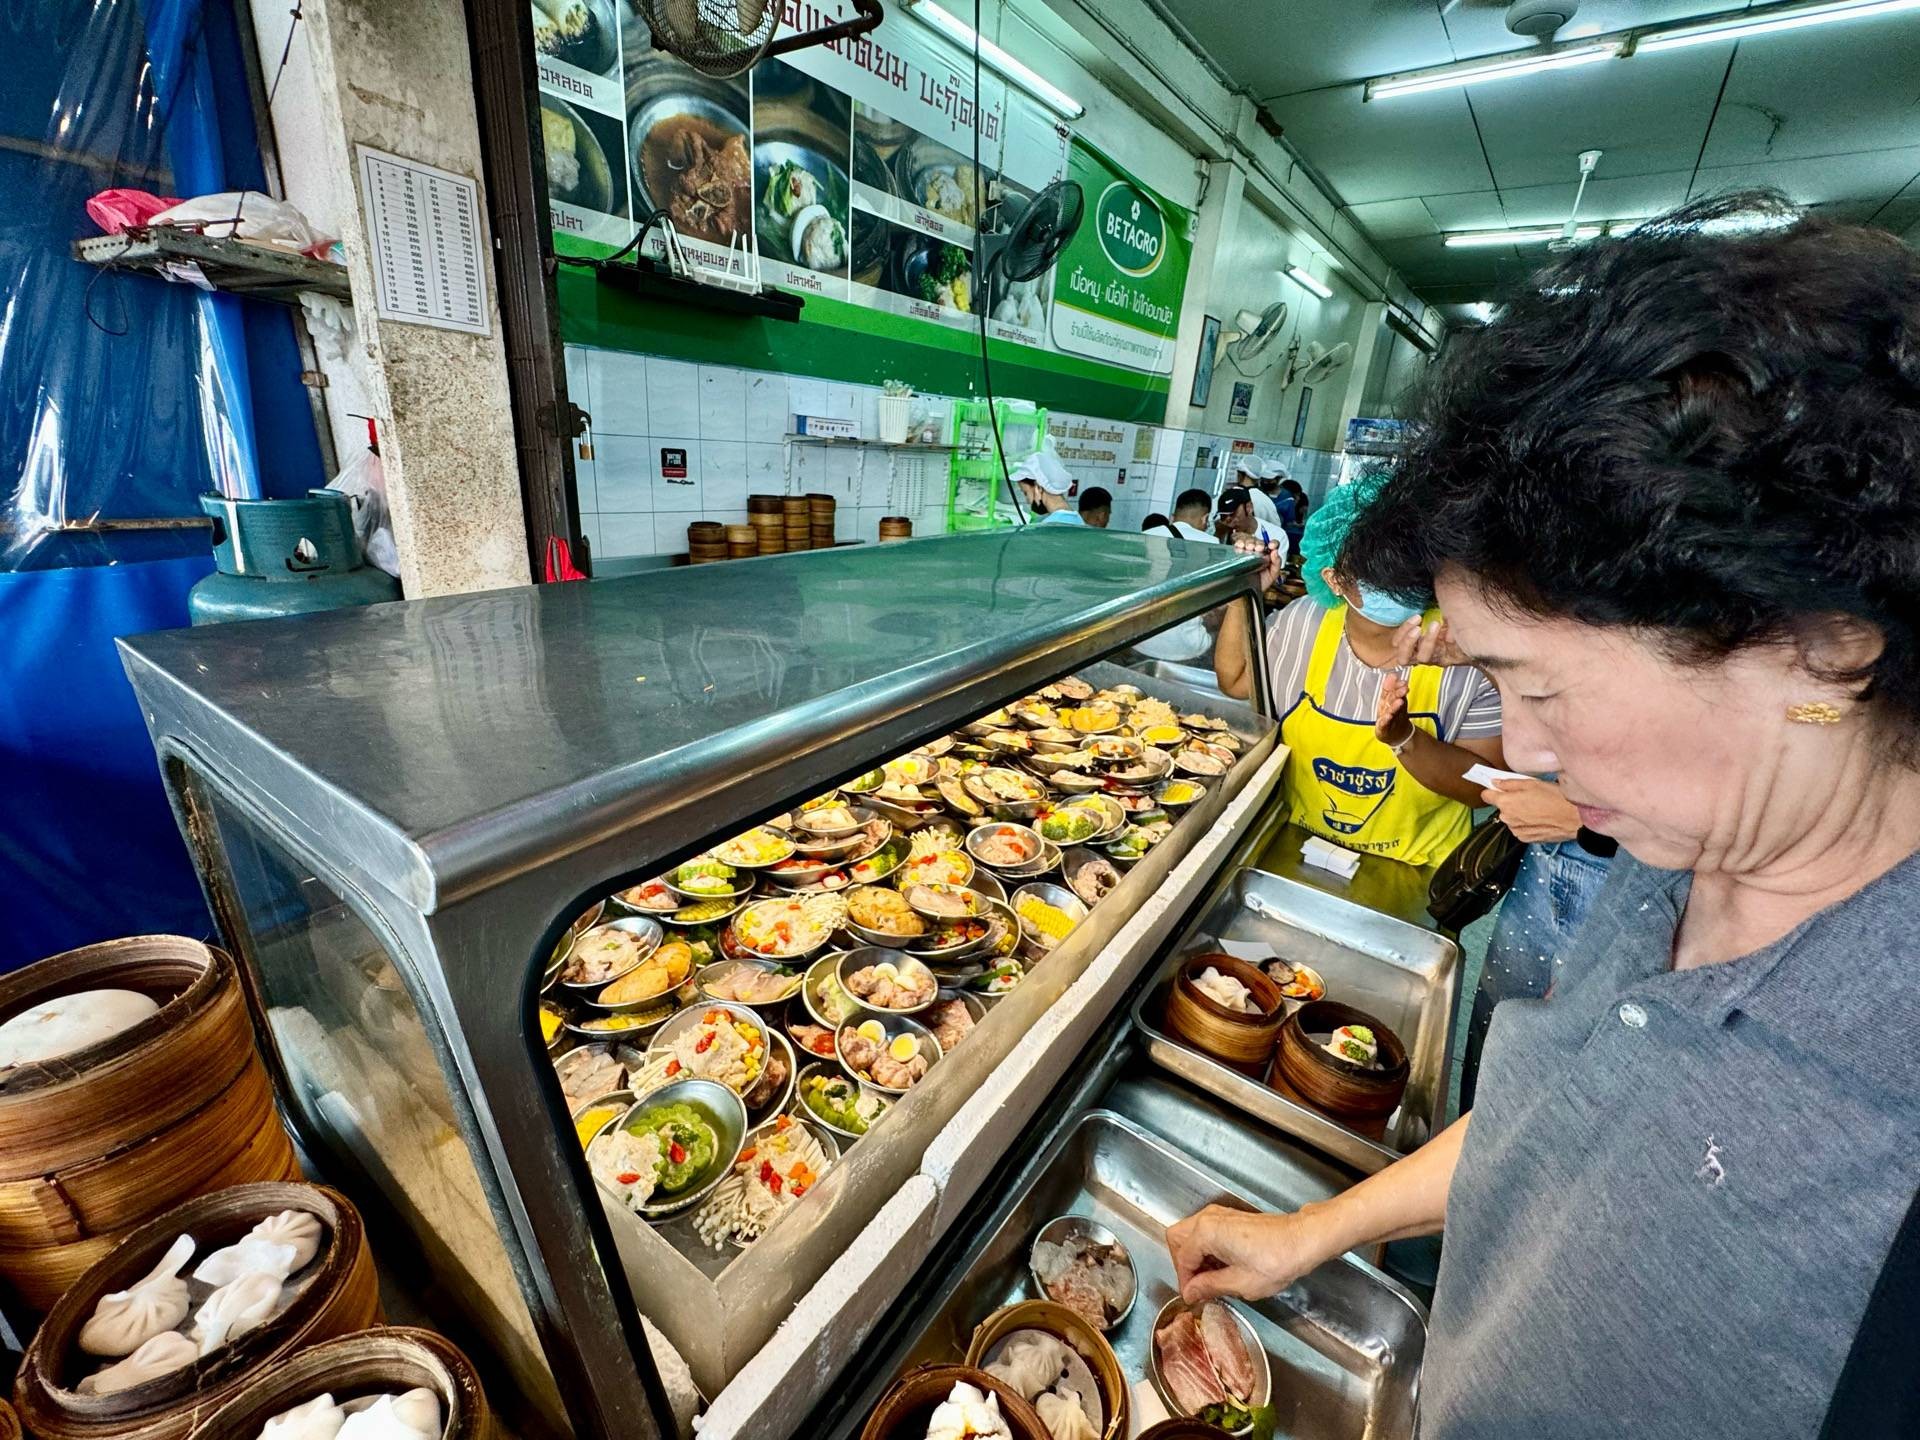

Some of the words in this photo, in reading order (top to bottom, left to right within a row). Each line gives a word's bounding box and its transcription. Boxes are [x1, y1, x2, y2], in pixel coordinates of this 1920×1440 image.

[537, 64, 593, 99] วหลอด
[1106, 212, 1158, 257] BETAGRO
[786, 271, 822, 291] ปลาหมึก
[1070, 265, 1101, 304] เนื้อหมู
[1105, 279, 1130, 309] เนื้อไก่
[1318, 764, 1388, 793] ราชาชูรส
